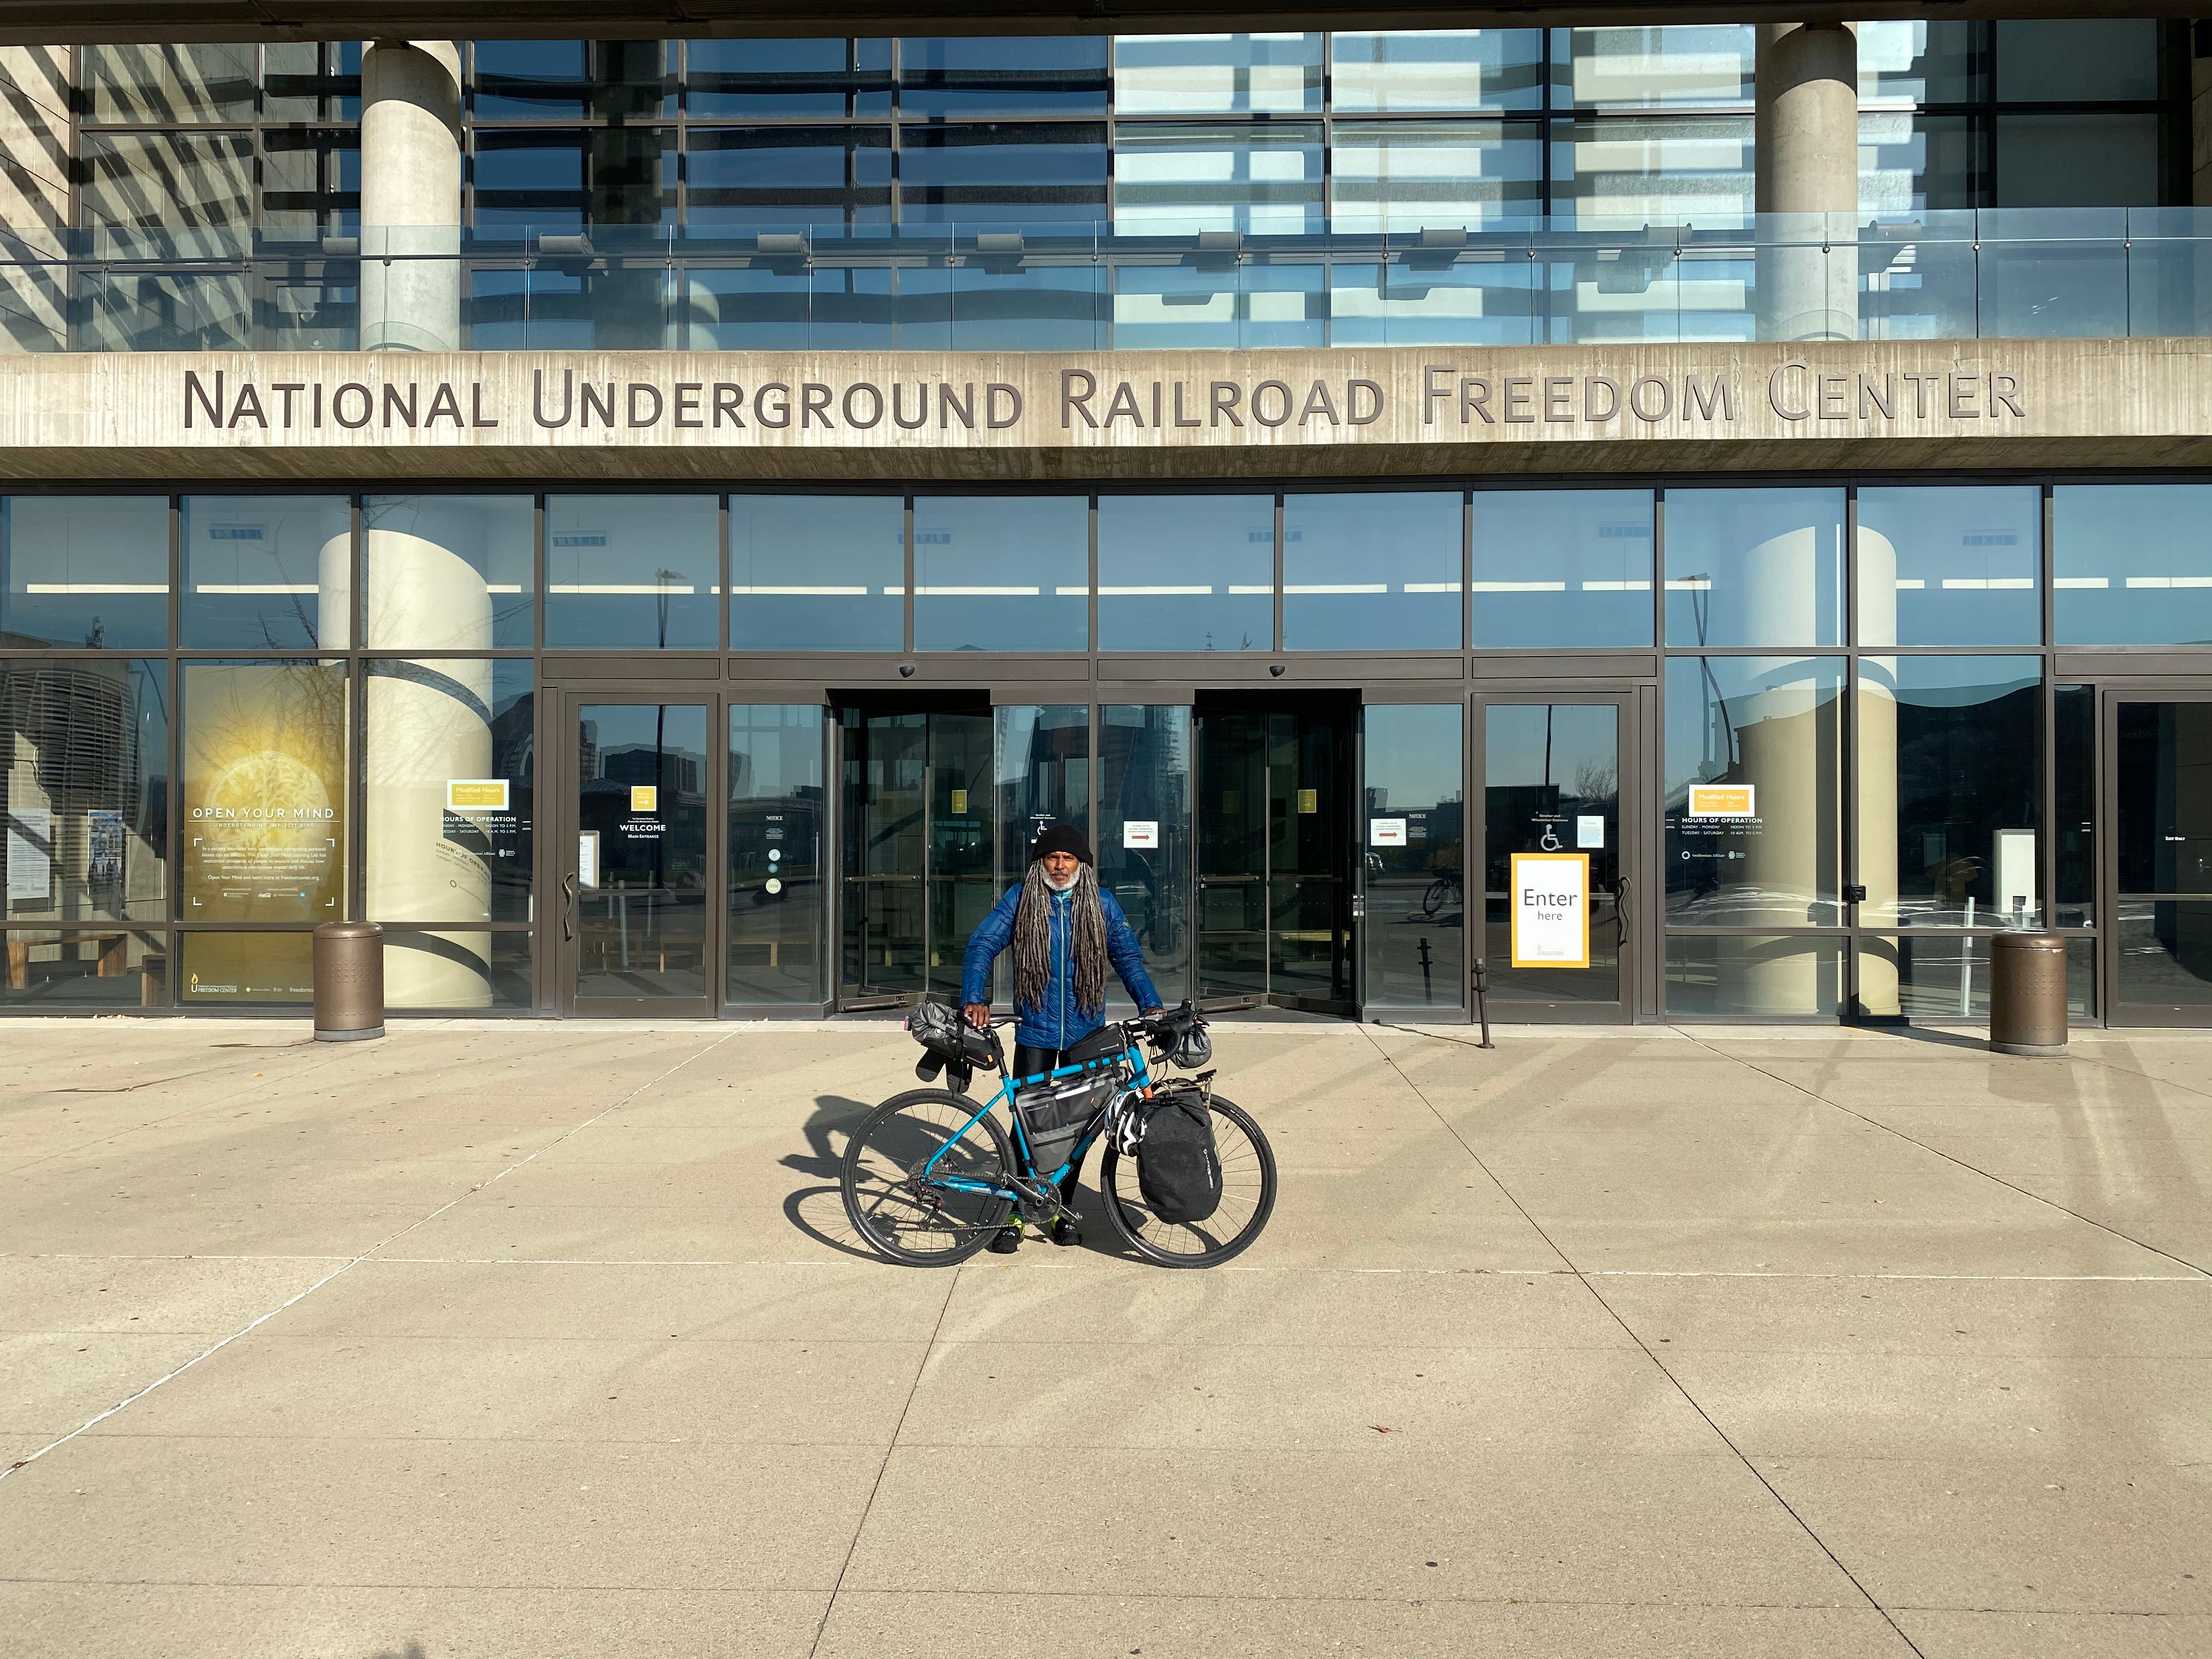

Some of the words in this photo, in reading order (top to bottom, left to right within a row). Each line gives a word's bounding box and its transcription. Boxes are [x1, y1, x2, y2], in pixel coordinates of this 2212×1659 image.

[184, 370, 499, 428] NATIONAL
[533, 369, 1023, 429] UNDERGROUND
[1061, 369, 1384, 428] RAILROAD
[1424, 364, 1734, 424] FREEDOM
[1769, 359, 2025, 421] CENTER
[193, 808, 235, 818] OPEN
[243, 808, 285, 818] YOUR
[294, 808, 334, 819] MIND
[1524, 889, 1578, 906] Enter
[1538, 911, 1563, 920] here
